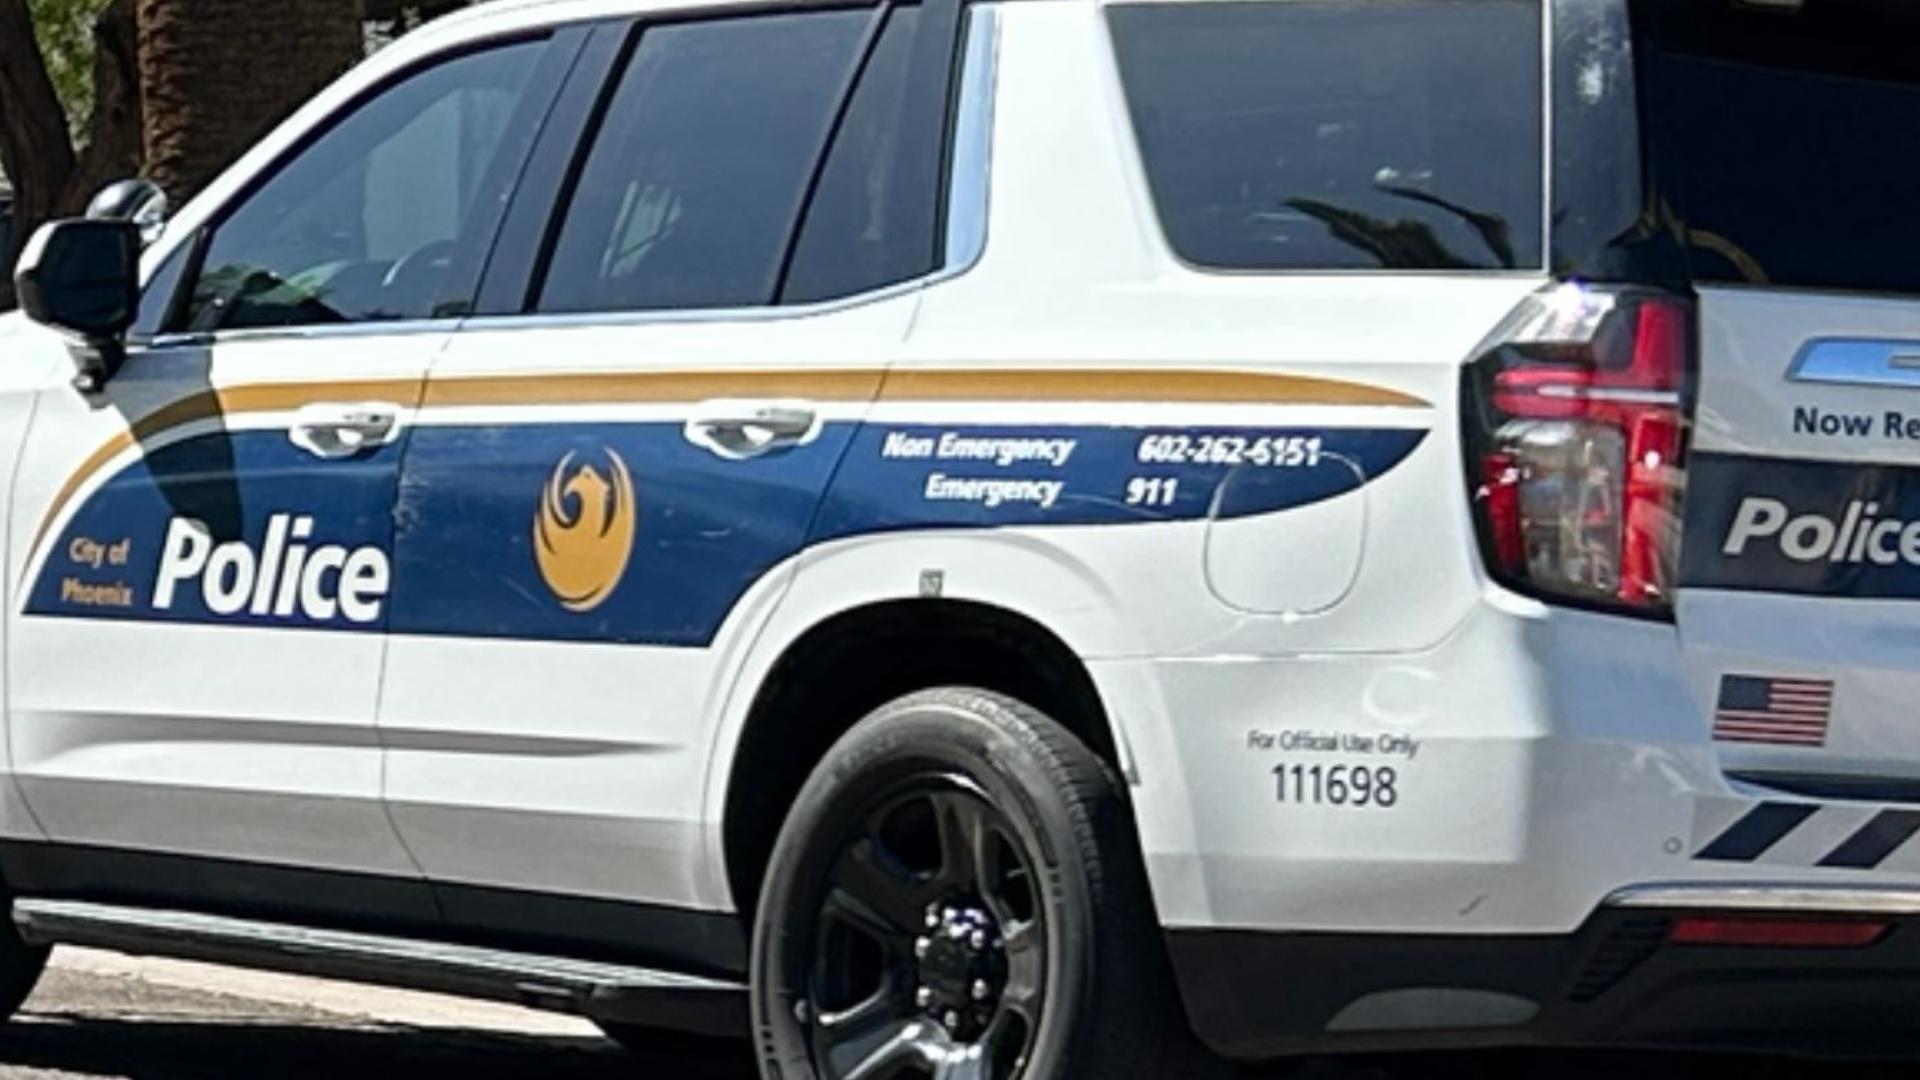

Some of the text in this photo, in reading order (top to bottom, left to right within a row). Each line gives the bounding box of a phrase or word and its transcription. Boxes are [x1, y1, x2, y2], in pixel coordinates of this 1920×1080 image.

[1793, 406, 1872, 436] Now
[882, 432, 1321, 467] Non Emergency 602-262-6151
[925, 473, 1178, 508] Emergency 911
[1723, 497, 1920, 566] Police
[69, 538, 131, 568] City of
[152, 514, 389, 622] Police
[62, 577, 132, 606] Phoenix
[1248, 730, 1420, 760] For Official Use Only
[1271, 763, 1397, 807] 111698
